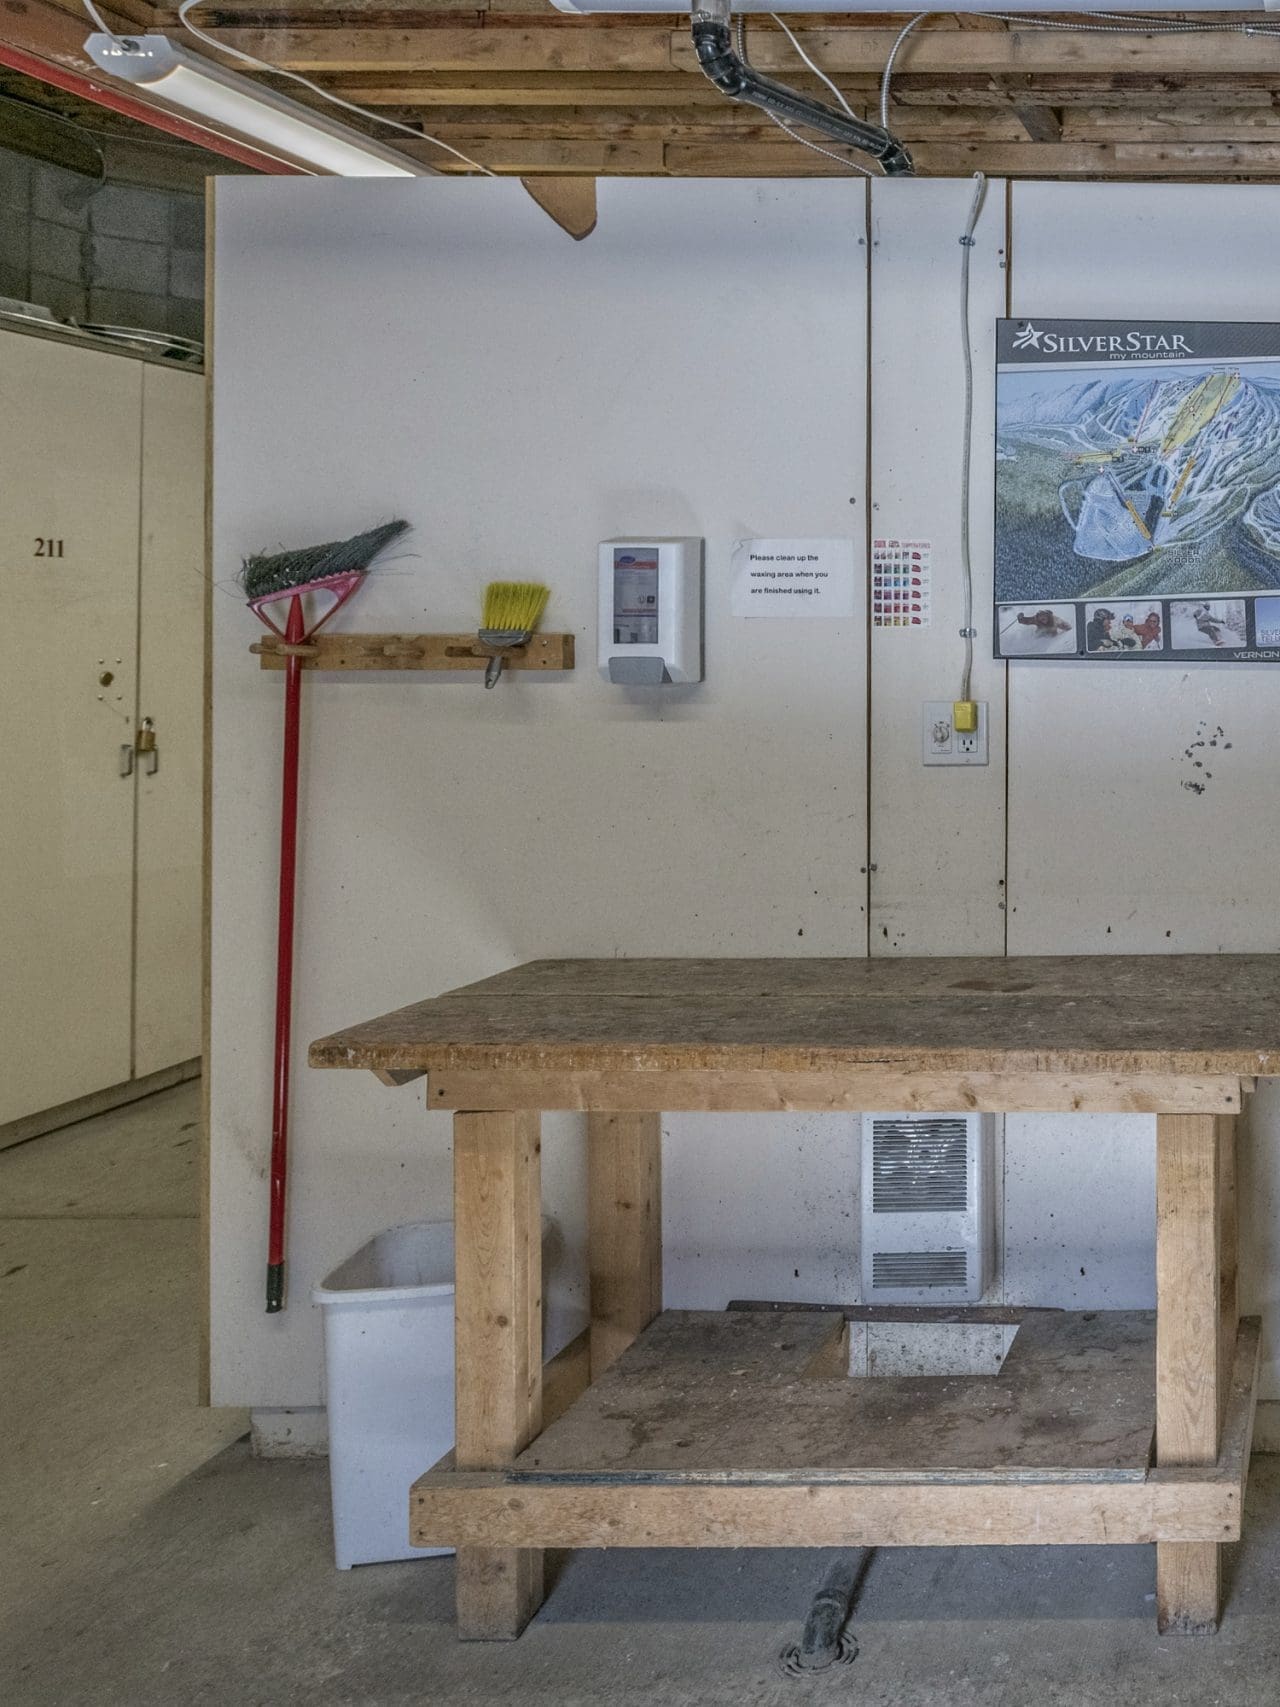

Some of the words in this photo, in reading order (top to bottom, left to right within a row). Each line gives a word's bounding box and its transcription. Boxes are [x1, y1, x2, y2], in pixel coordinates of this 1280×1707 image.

[1130, 351, 1185, 359] mountain
[34, 537, 64, 558] 211
[750, 571, 776, 579] waxing
